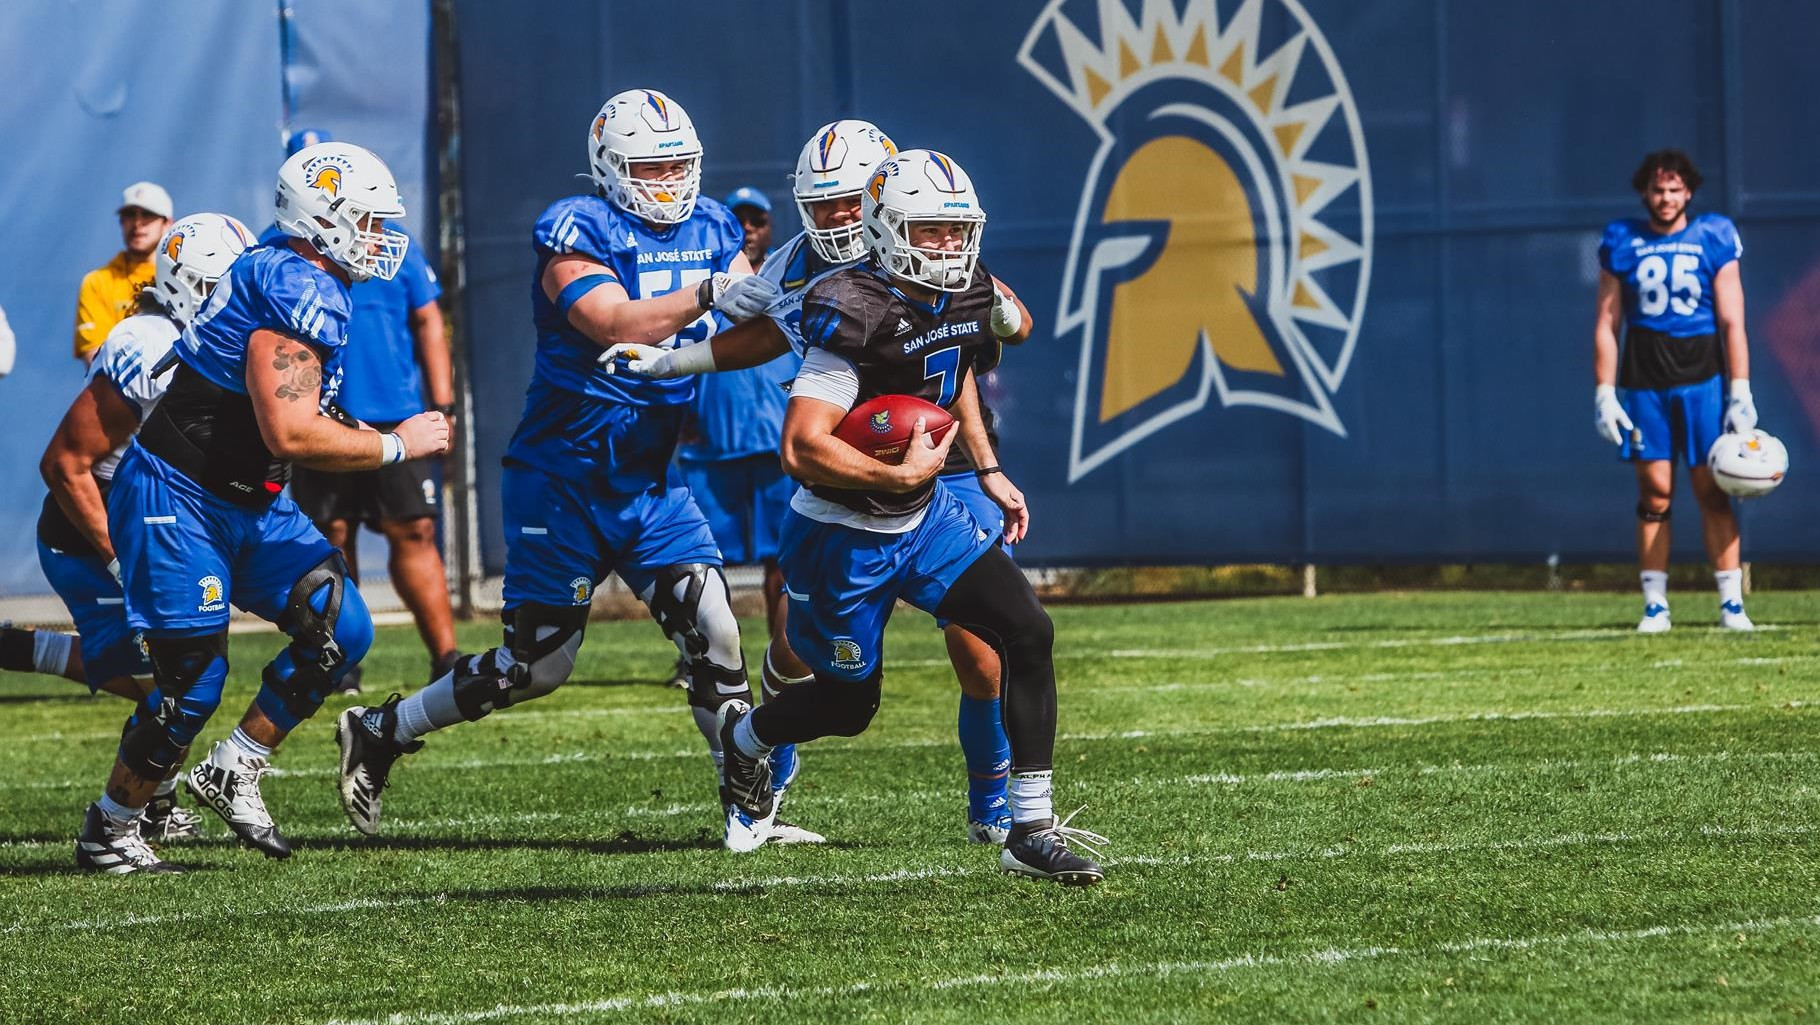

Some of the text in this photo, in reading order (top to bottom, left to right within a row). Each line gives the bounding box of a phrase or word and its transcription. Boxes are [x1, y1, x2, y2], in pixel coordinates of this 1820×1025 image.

[636, 248, 713, 265] AN JOSÉ STATE
[1636, 254, 1702, 316] 85
[903, 335, 925, 354] SAN
[925, 322, 950, 344] JOSÉ
[950, 321, 979, 336] STATE
[924, 345, 961, 406] 7
[229, 481, 254, 493] ACE
[197, 602, 226, 612] FOOTBALL
[830, 660, 867, 670] FOOTBALL
[193, 763, 235, 820] adidas
